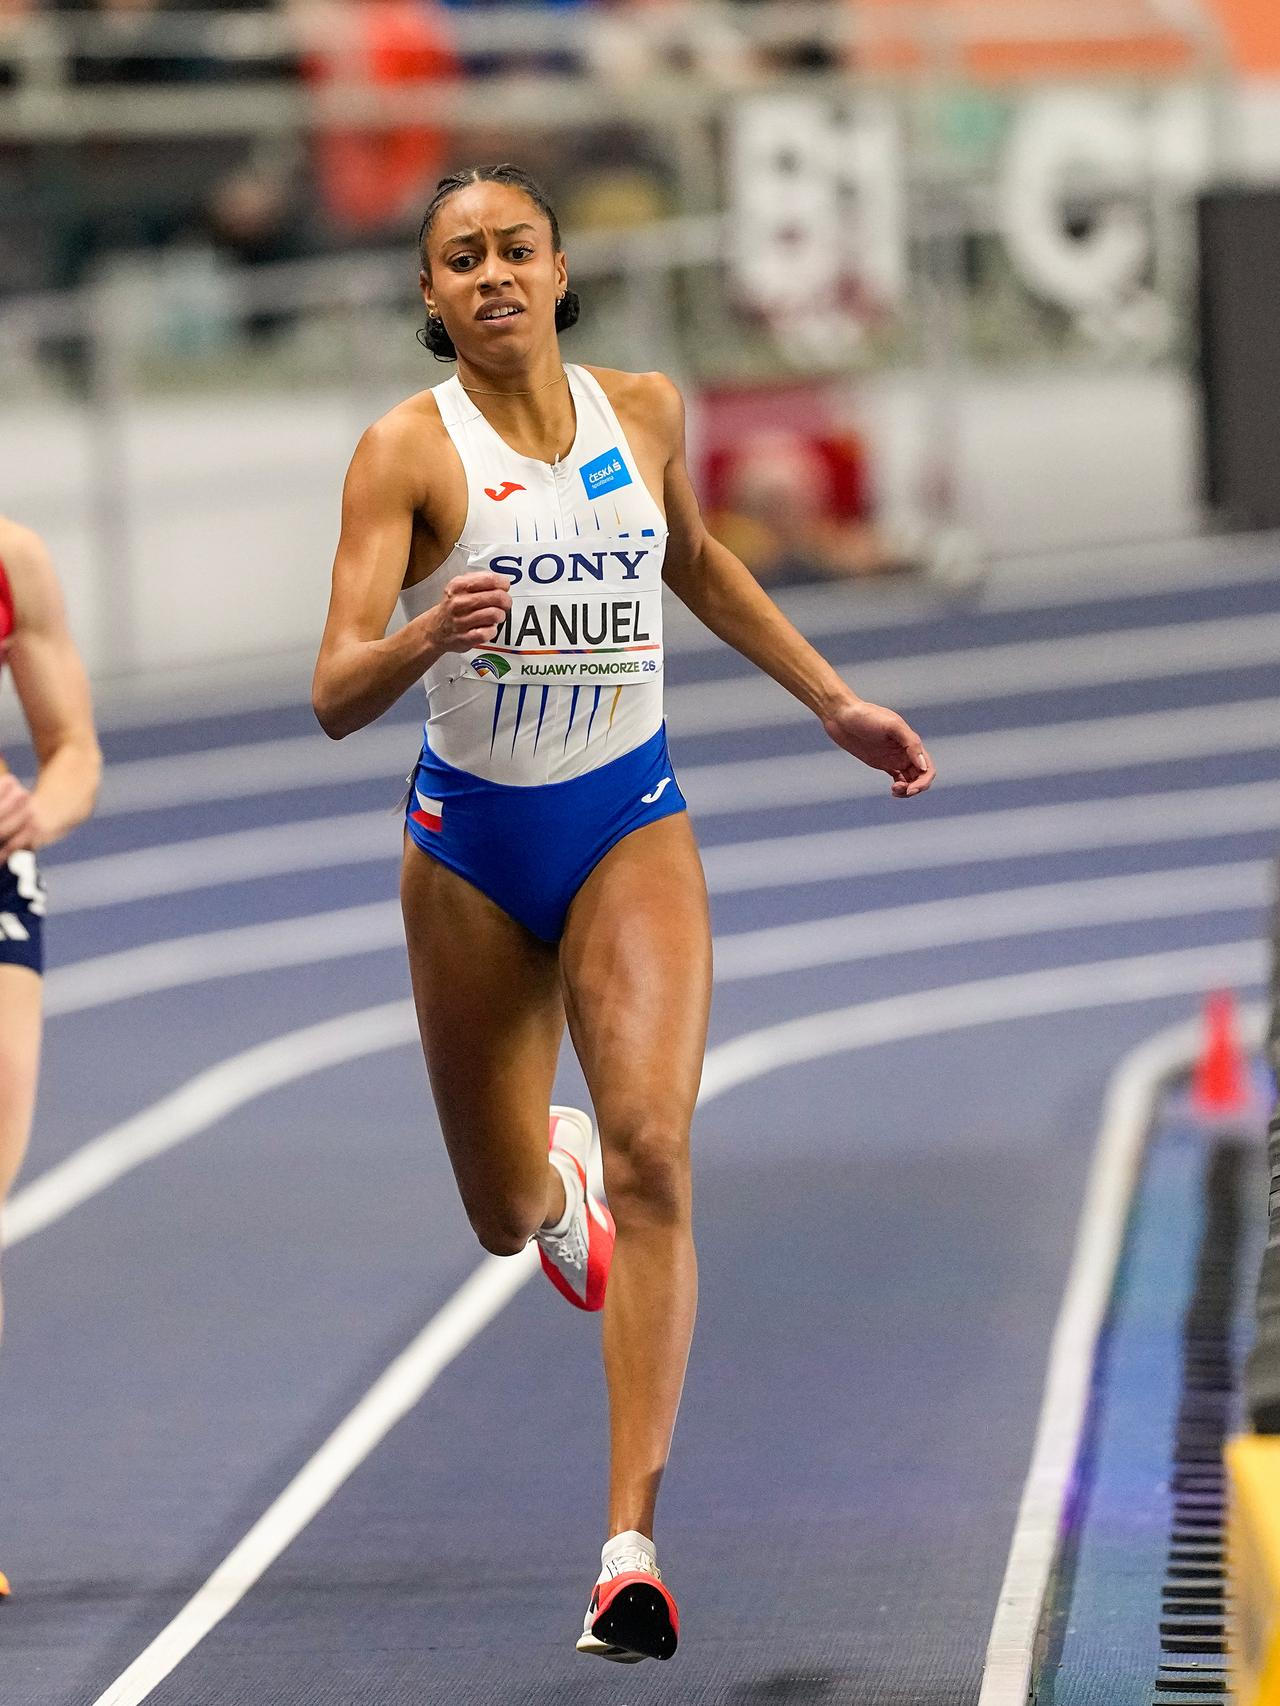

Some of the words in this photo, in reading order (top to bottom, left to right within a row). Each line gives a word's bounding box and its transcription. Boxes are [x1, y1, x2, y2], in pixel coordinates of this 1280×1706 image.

[489, 550, 649, 586] SONY
[521, 664, 576, 676] KUJAWY
[579, 661, 640, 675] POMORZE
[641, 660, 656, 672] 26
